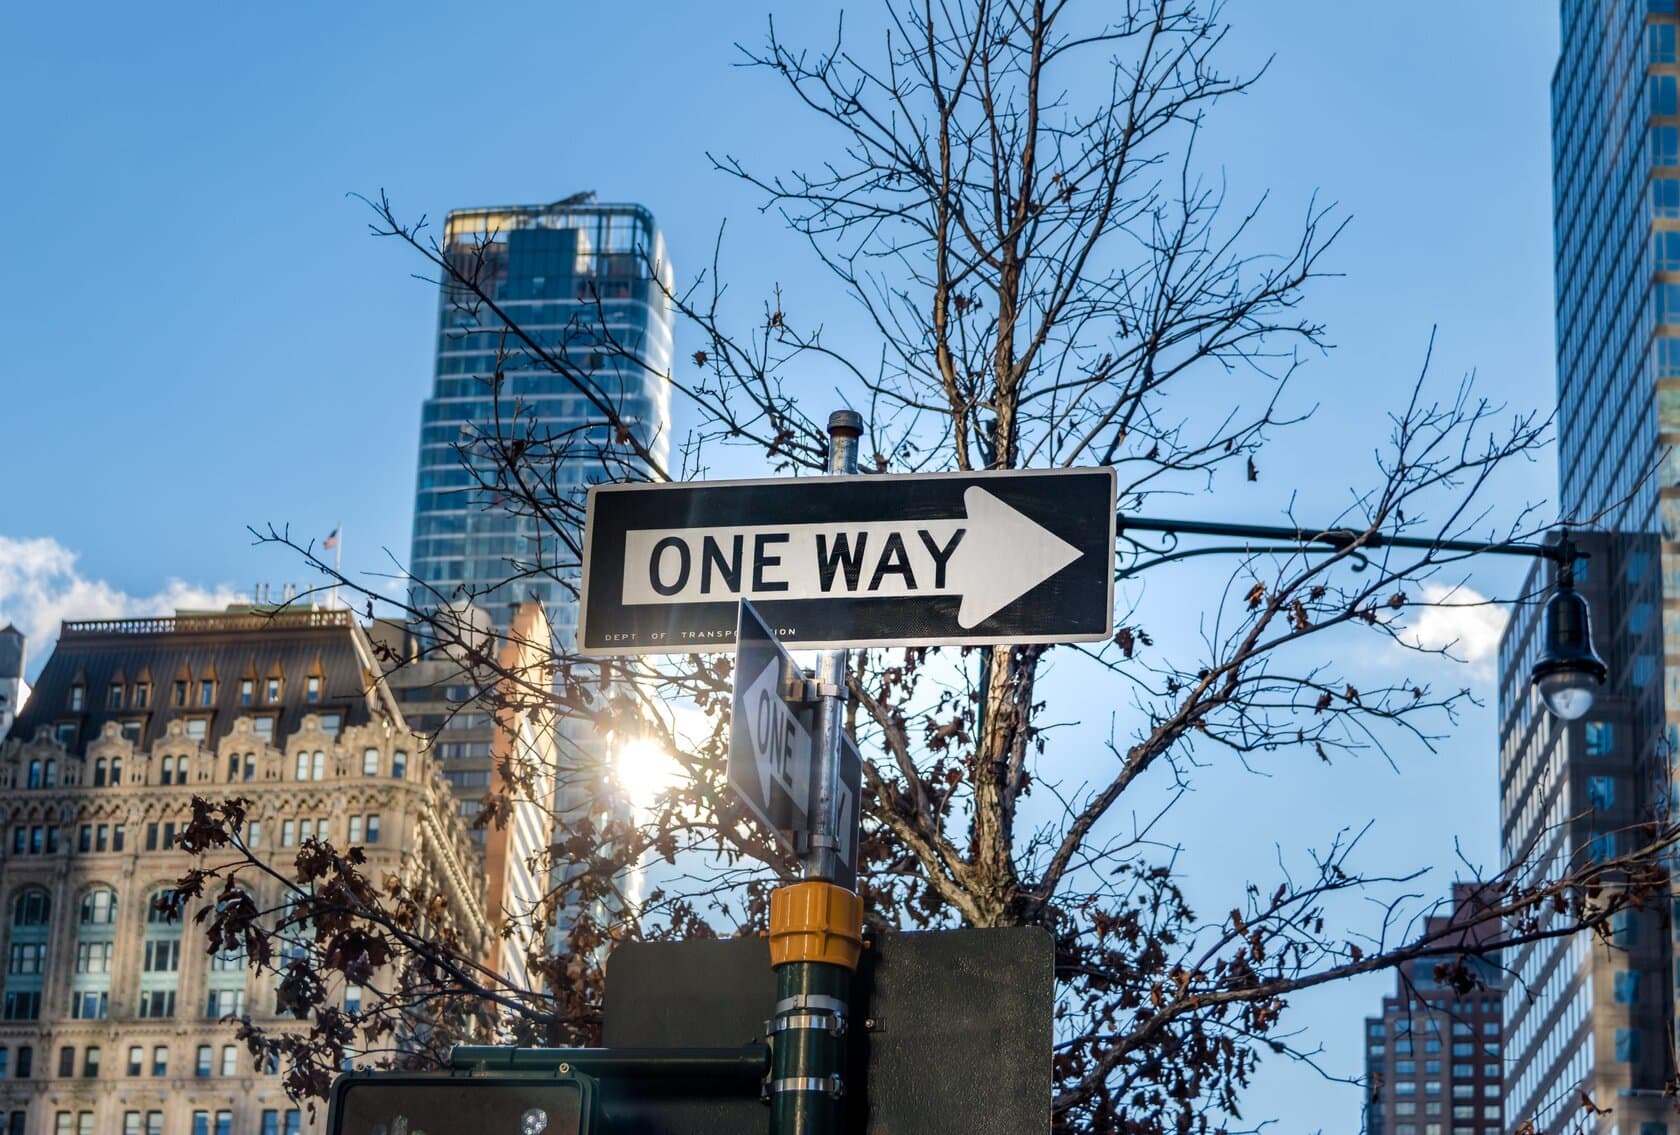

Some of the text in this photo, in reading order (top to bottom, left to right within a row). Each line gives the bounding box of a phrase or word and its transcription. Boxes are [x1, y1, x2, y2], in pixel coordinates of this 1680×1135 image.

[649, 528, 967, 597] ONE WAY
[605, 633, 638, 641] DEPT
[651, 632, 668, 640] OF
[757, 688, 796, 788] ONE
